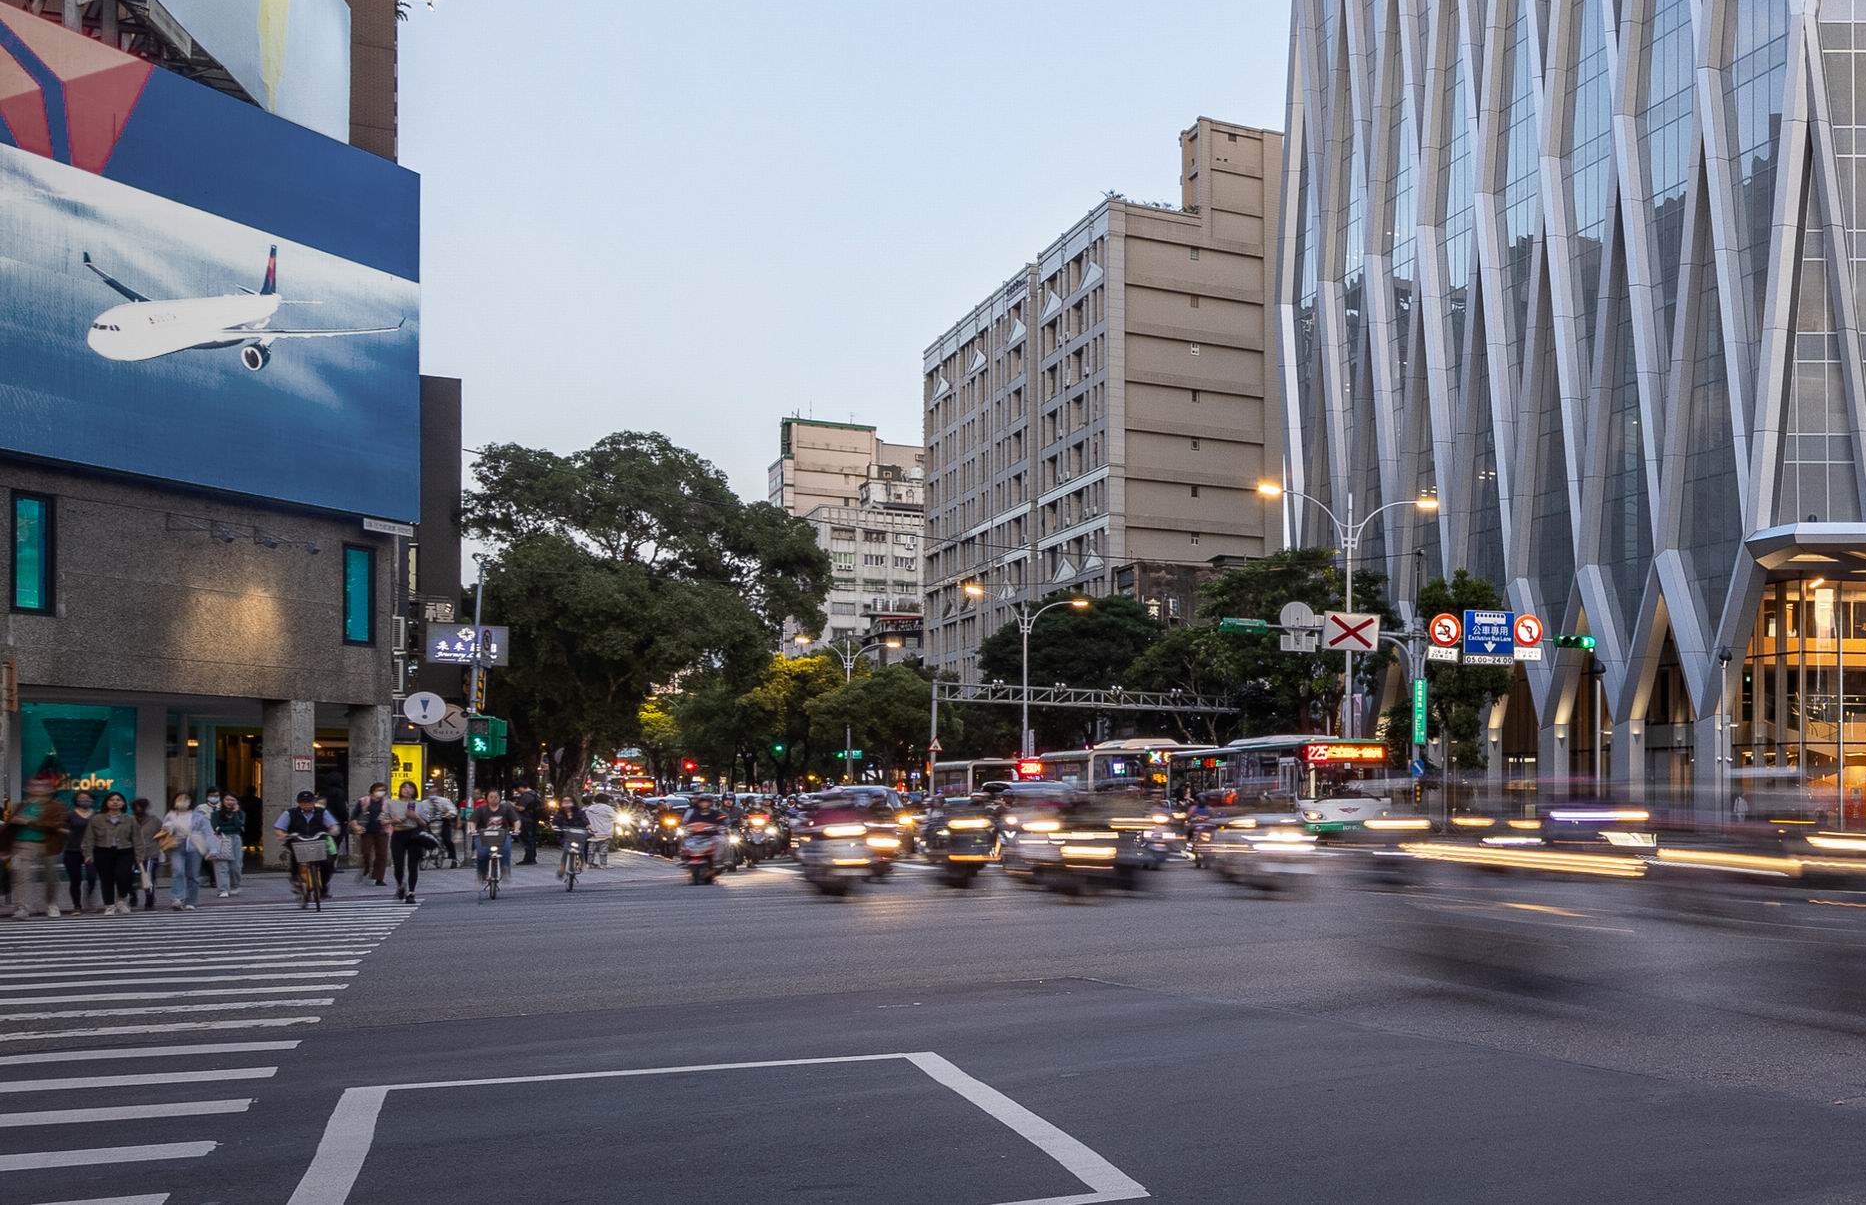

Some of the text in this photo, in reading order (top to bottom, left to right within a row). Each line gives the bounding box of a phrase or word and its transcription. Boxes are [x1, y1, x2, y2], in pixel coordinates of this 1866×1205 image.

[1472, 626, 1508, 635] 公車專用
[1308, 744, 1328, 760] 225
[296, 761, 311, 770] 171
